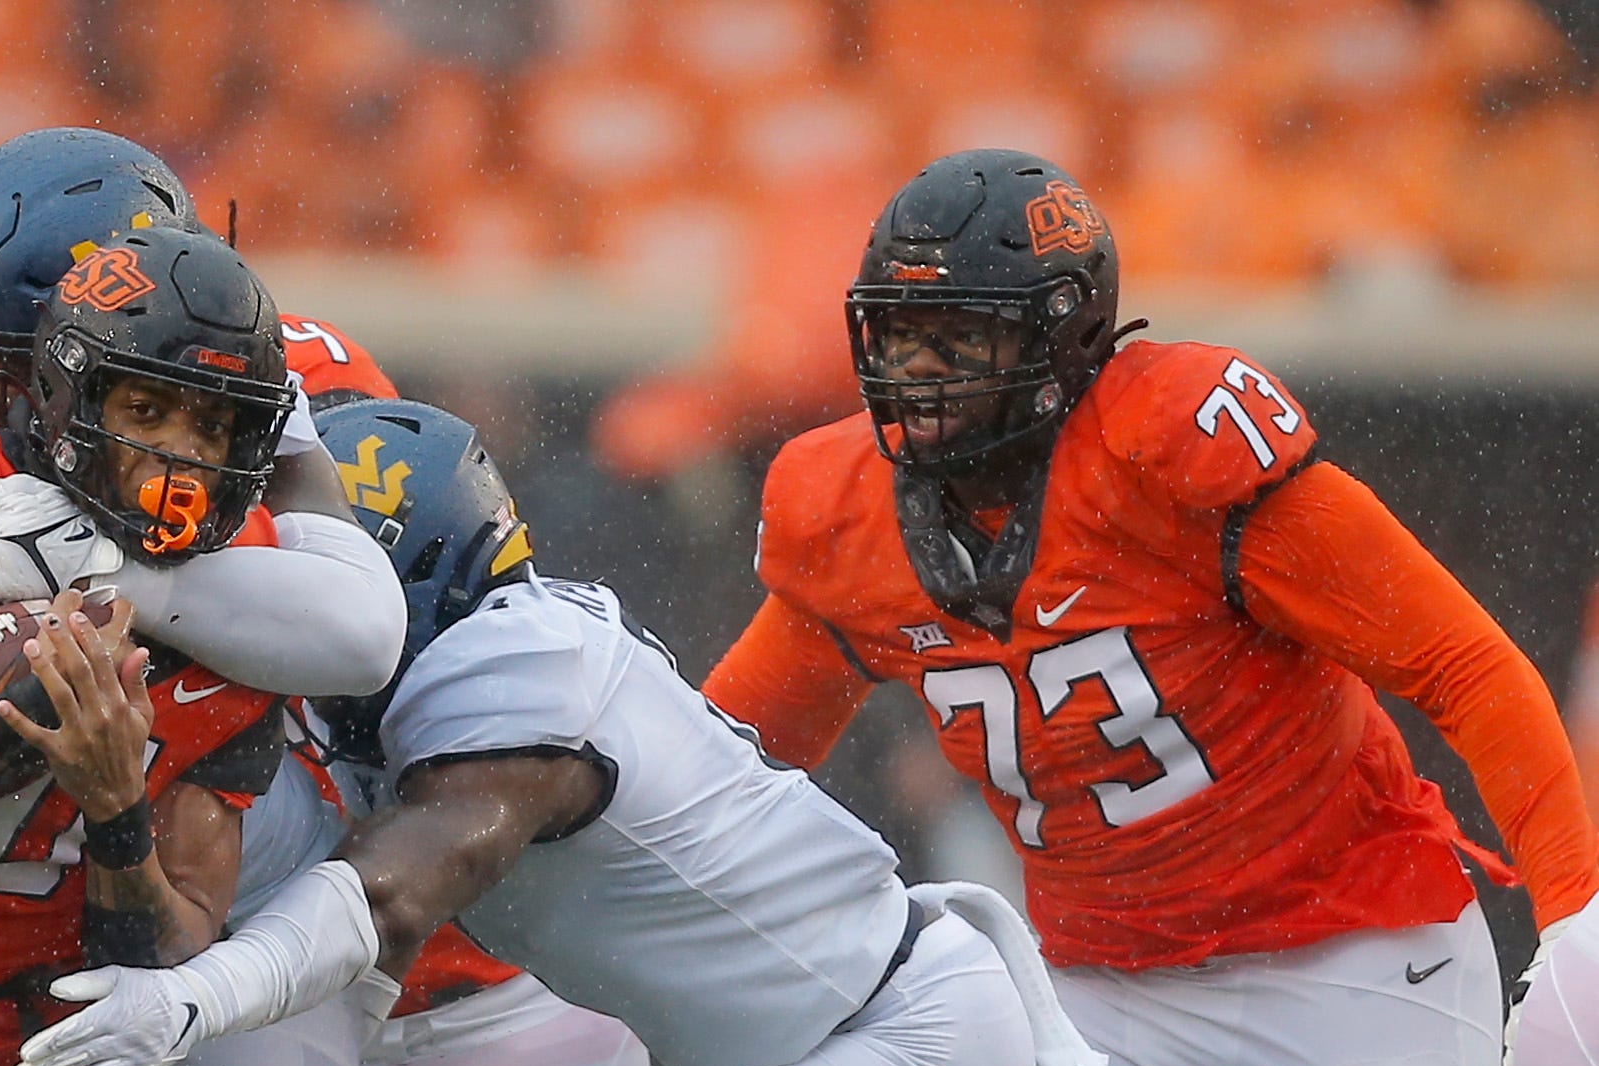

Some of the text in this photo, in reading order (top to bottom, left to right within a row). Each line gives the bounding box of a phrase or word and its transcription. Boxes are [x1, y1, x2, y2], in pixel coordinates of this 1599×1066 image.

[1193, 356, 1302, 471] 73
[898, 621, 953, 655] XII
[920, 625, 1220, 849] 73
